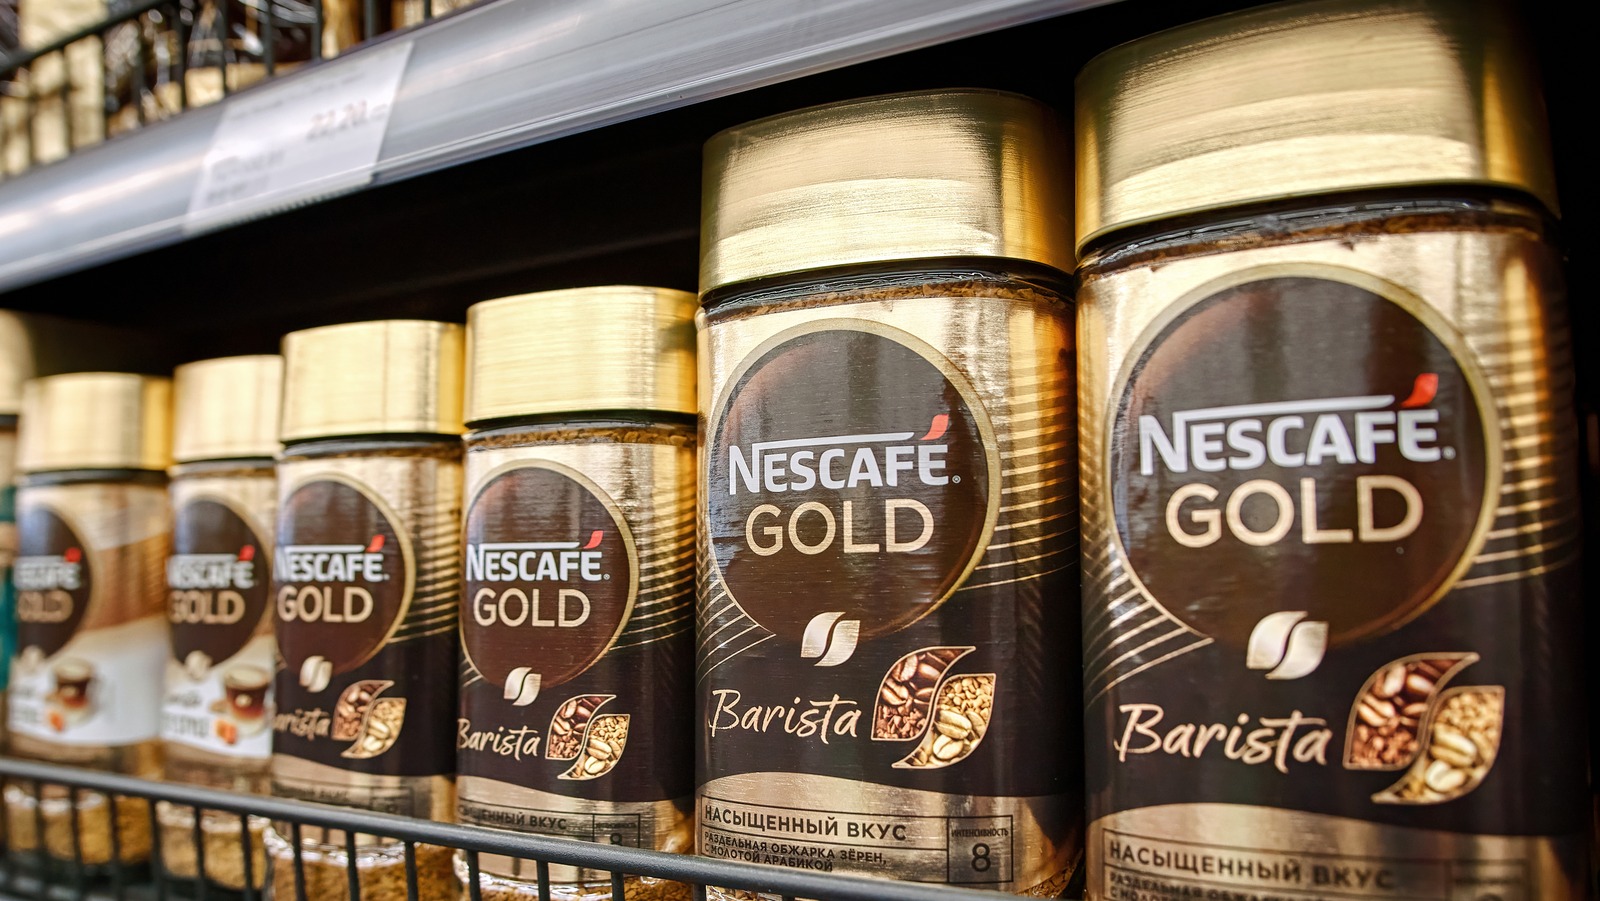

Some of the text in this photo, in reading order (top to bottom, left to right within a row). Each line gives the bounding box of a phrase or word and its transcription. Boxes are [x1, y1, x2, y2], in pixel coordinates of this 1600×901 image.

[1138, 373, 1441, 476] NESCAFÉ
[728, 414, 950, 496] NESCAFÉ
[745, 498, 935, 557] GOLD
[1165, 474, 1424, 548] GOLD
[273, 534, 386, 582] NESCAFÉ
[465, 530, 604, 582] NESCAFÉ
[18, 591, 74, 624] OLD
[168, 590, 245, 624] GOLD
[277, 585, 374, 623] GOLD
[473, 588, 591, 628] GOLD
[273, 708, 331, 741] arista
[708, 689, 862, 744] Barista
[457, 718, 541, 761] Barista
[1114, 703, 1333, 773] Barista
[458, 805, 567, 830] СЫЩЕННЫЙ ВКУС
[705, 805, 907, 841] НАСЫЩЕННЫЙ ВКУС
[704, 831, 887, 865] РАЗДЕЛЬНАЯ ОБЖАРКА ЗЁРЕН,
[711, 846, 760, 863] МОЛОТОЙ
[763, 855, 833, 872] АРАБИКОЙ
[971, 843, 991, 872] 8
[1109, 840, 1396, 889] НАСЫЩЕННЫЙ ВКУС
